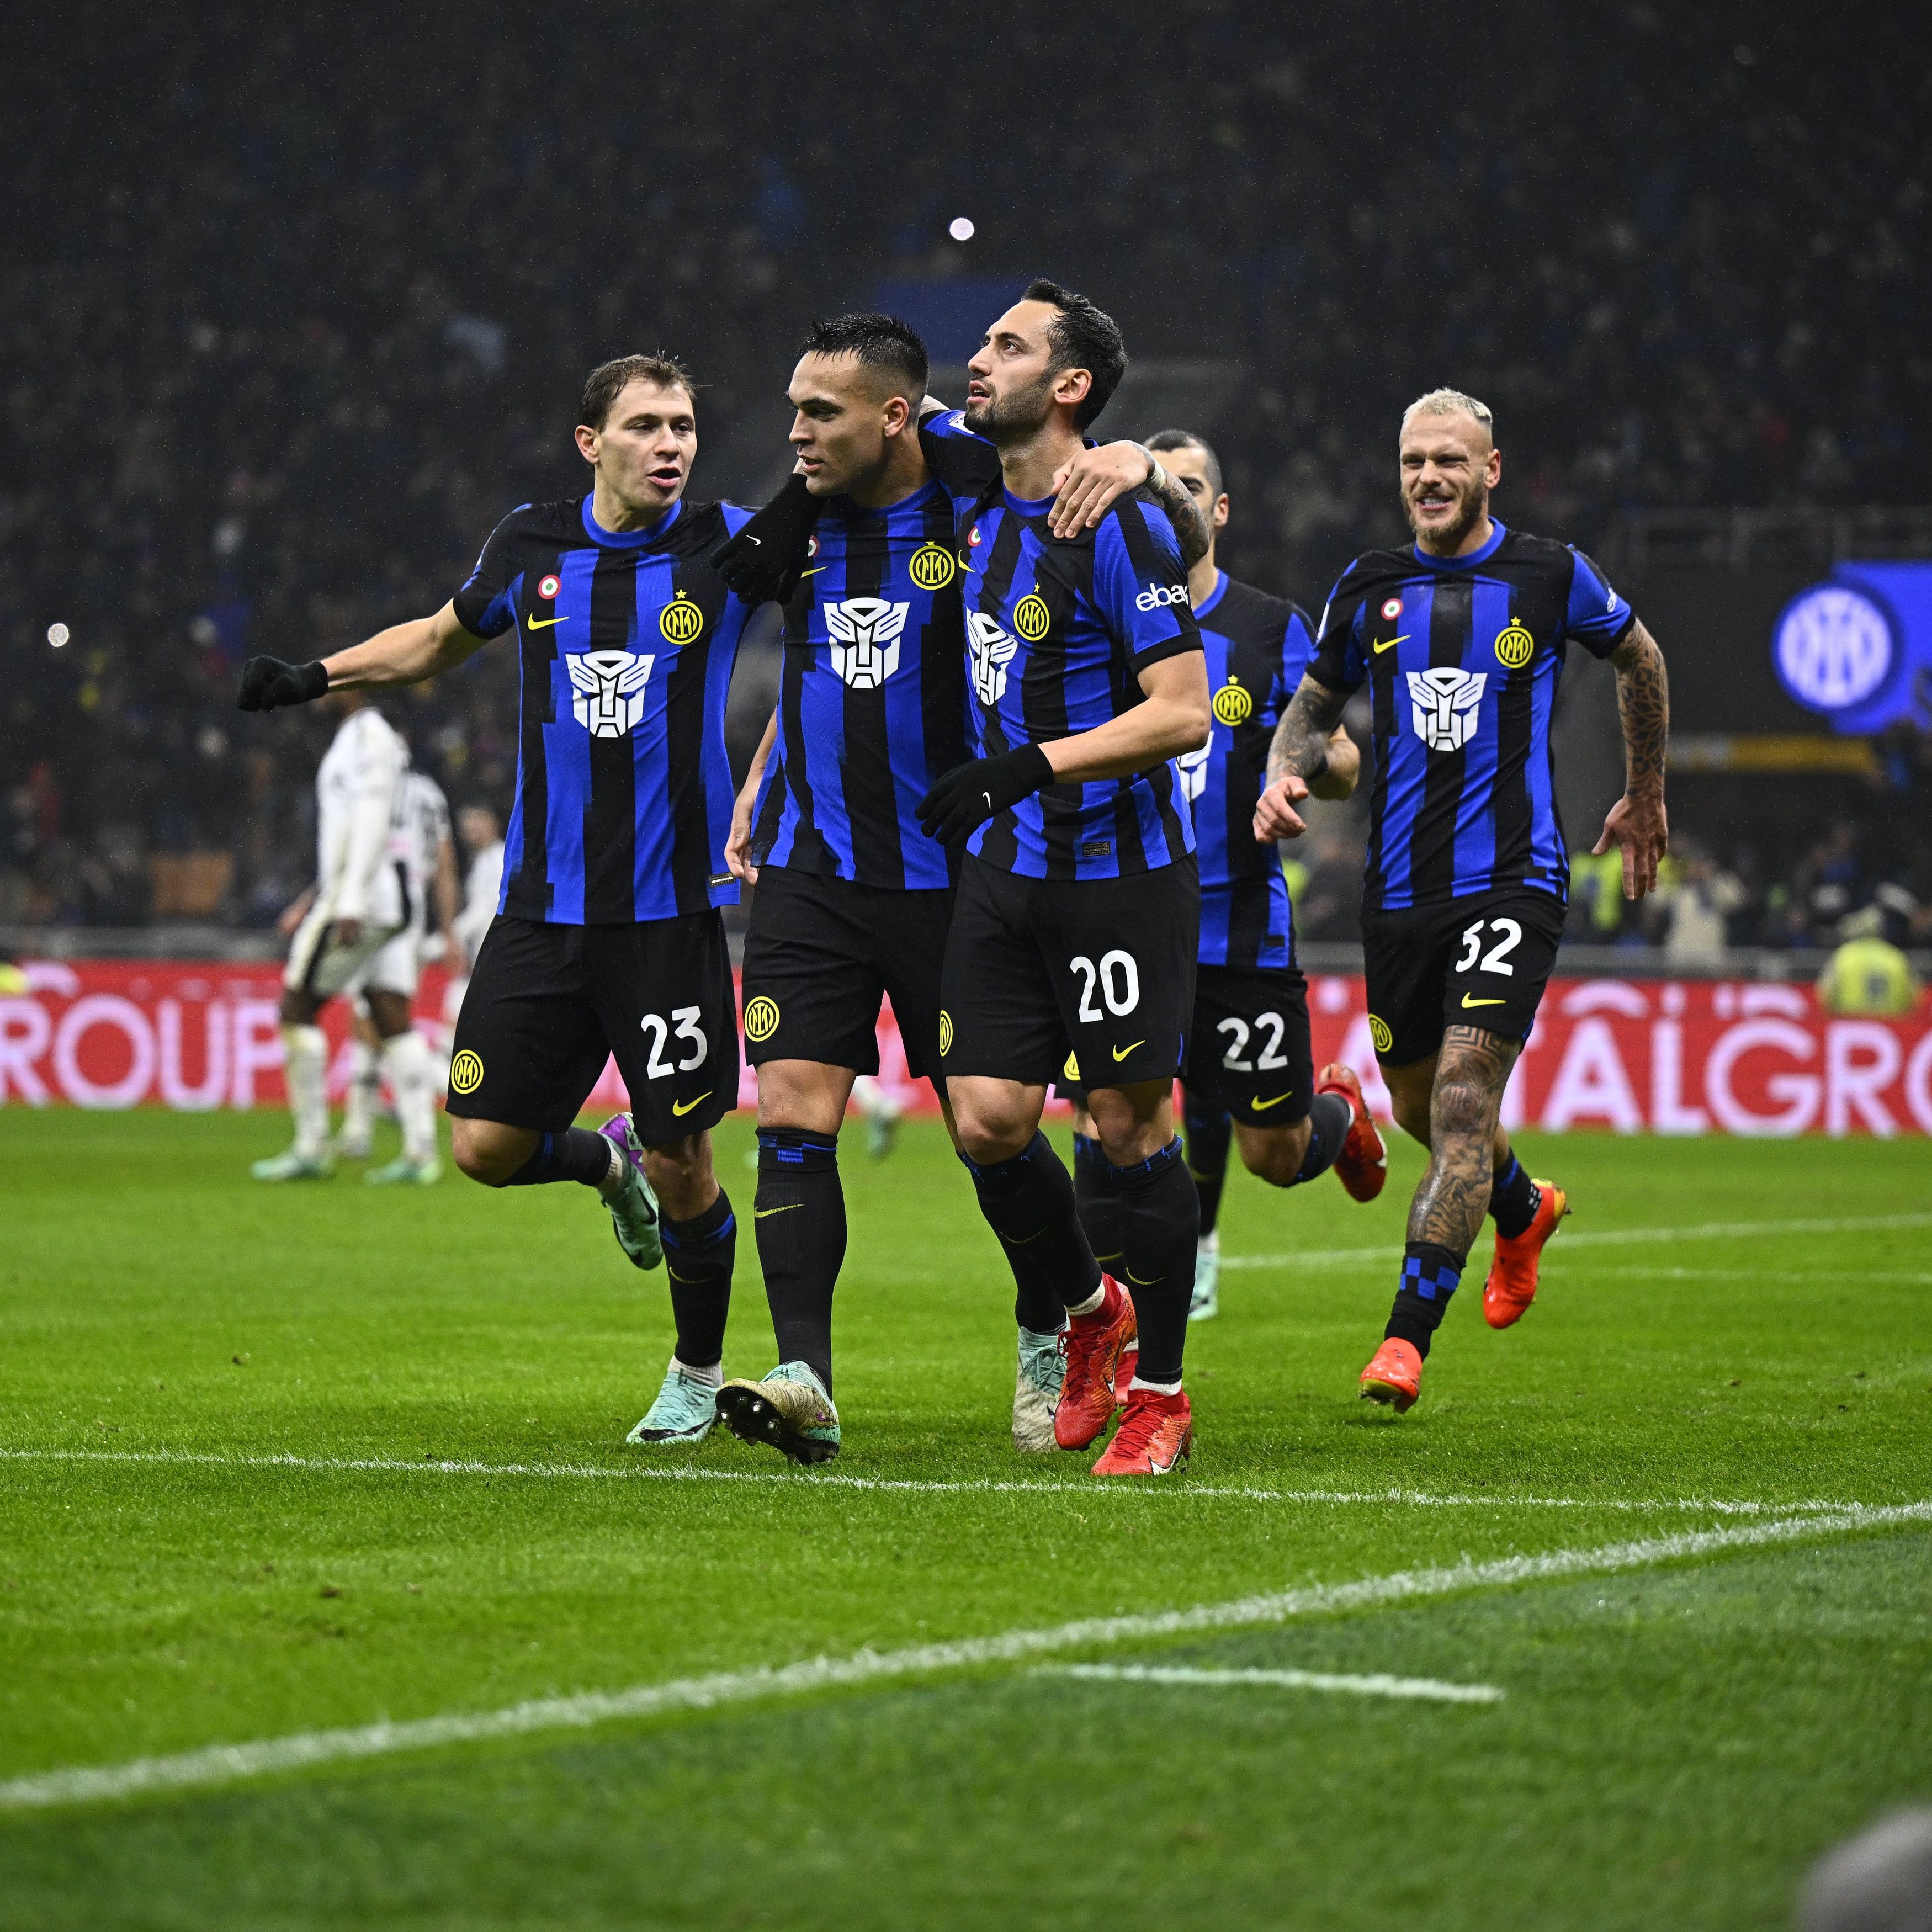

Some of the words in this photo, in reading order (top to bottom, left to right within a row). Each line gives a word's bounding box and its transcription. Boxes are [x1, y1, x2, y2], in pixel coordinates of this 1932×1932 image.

[1455, 917, 1522, 977] 32
[1069, 949, 1140, 1023] 20
[640, 1005, 708, 1080] 23
[1216, 1011, 1289, 1072] 22
